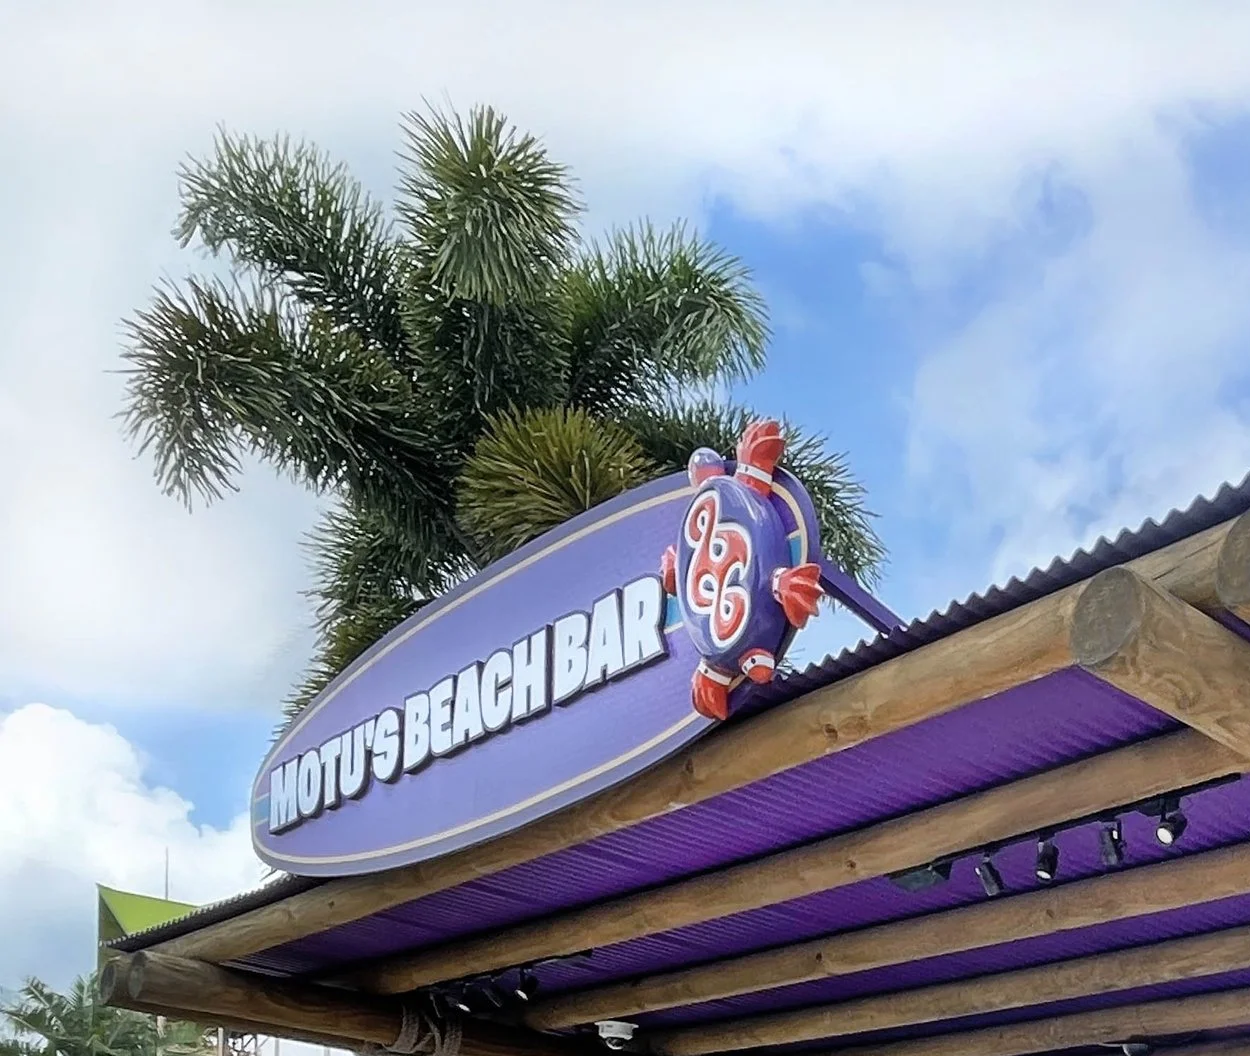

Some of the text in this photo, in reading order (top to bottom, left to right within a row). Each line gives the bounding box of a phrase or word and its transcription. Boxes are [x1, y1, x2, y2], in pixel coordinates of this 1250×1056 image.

[268, 574, 666, 834] MOTU'S BEACH BAR
